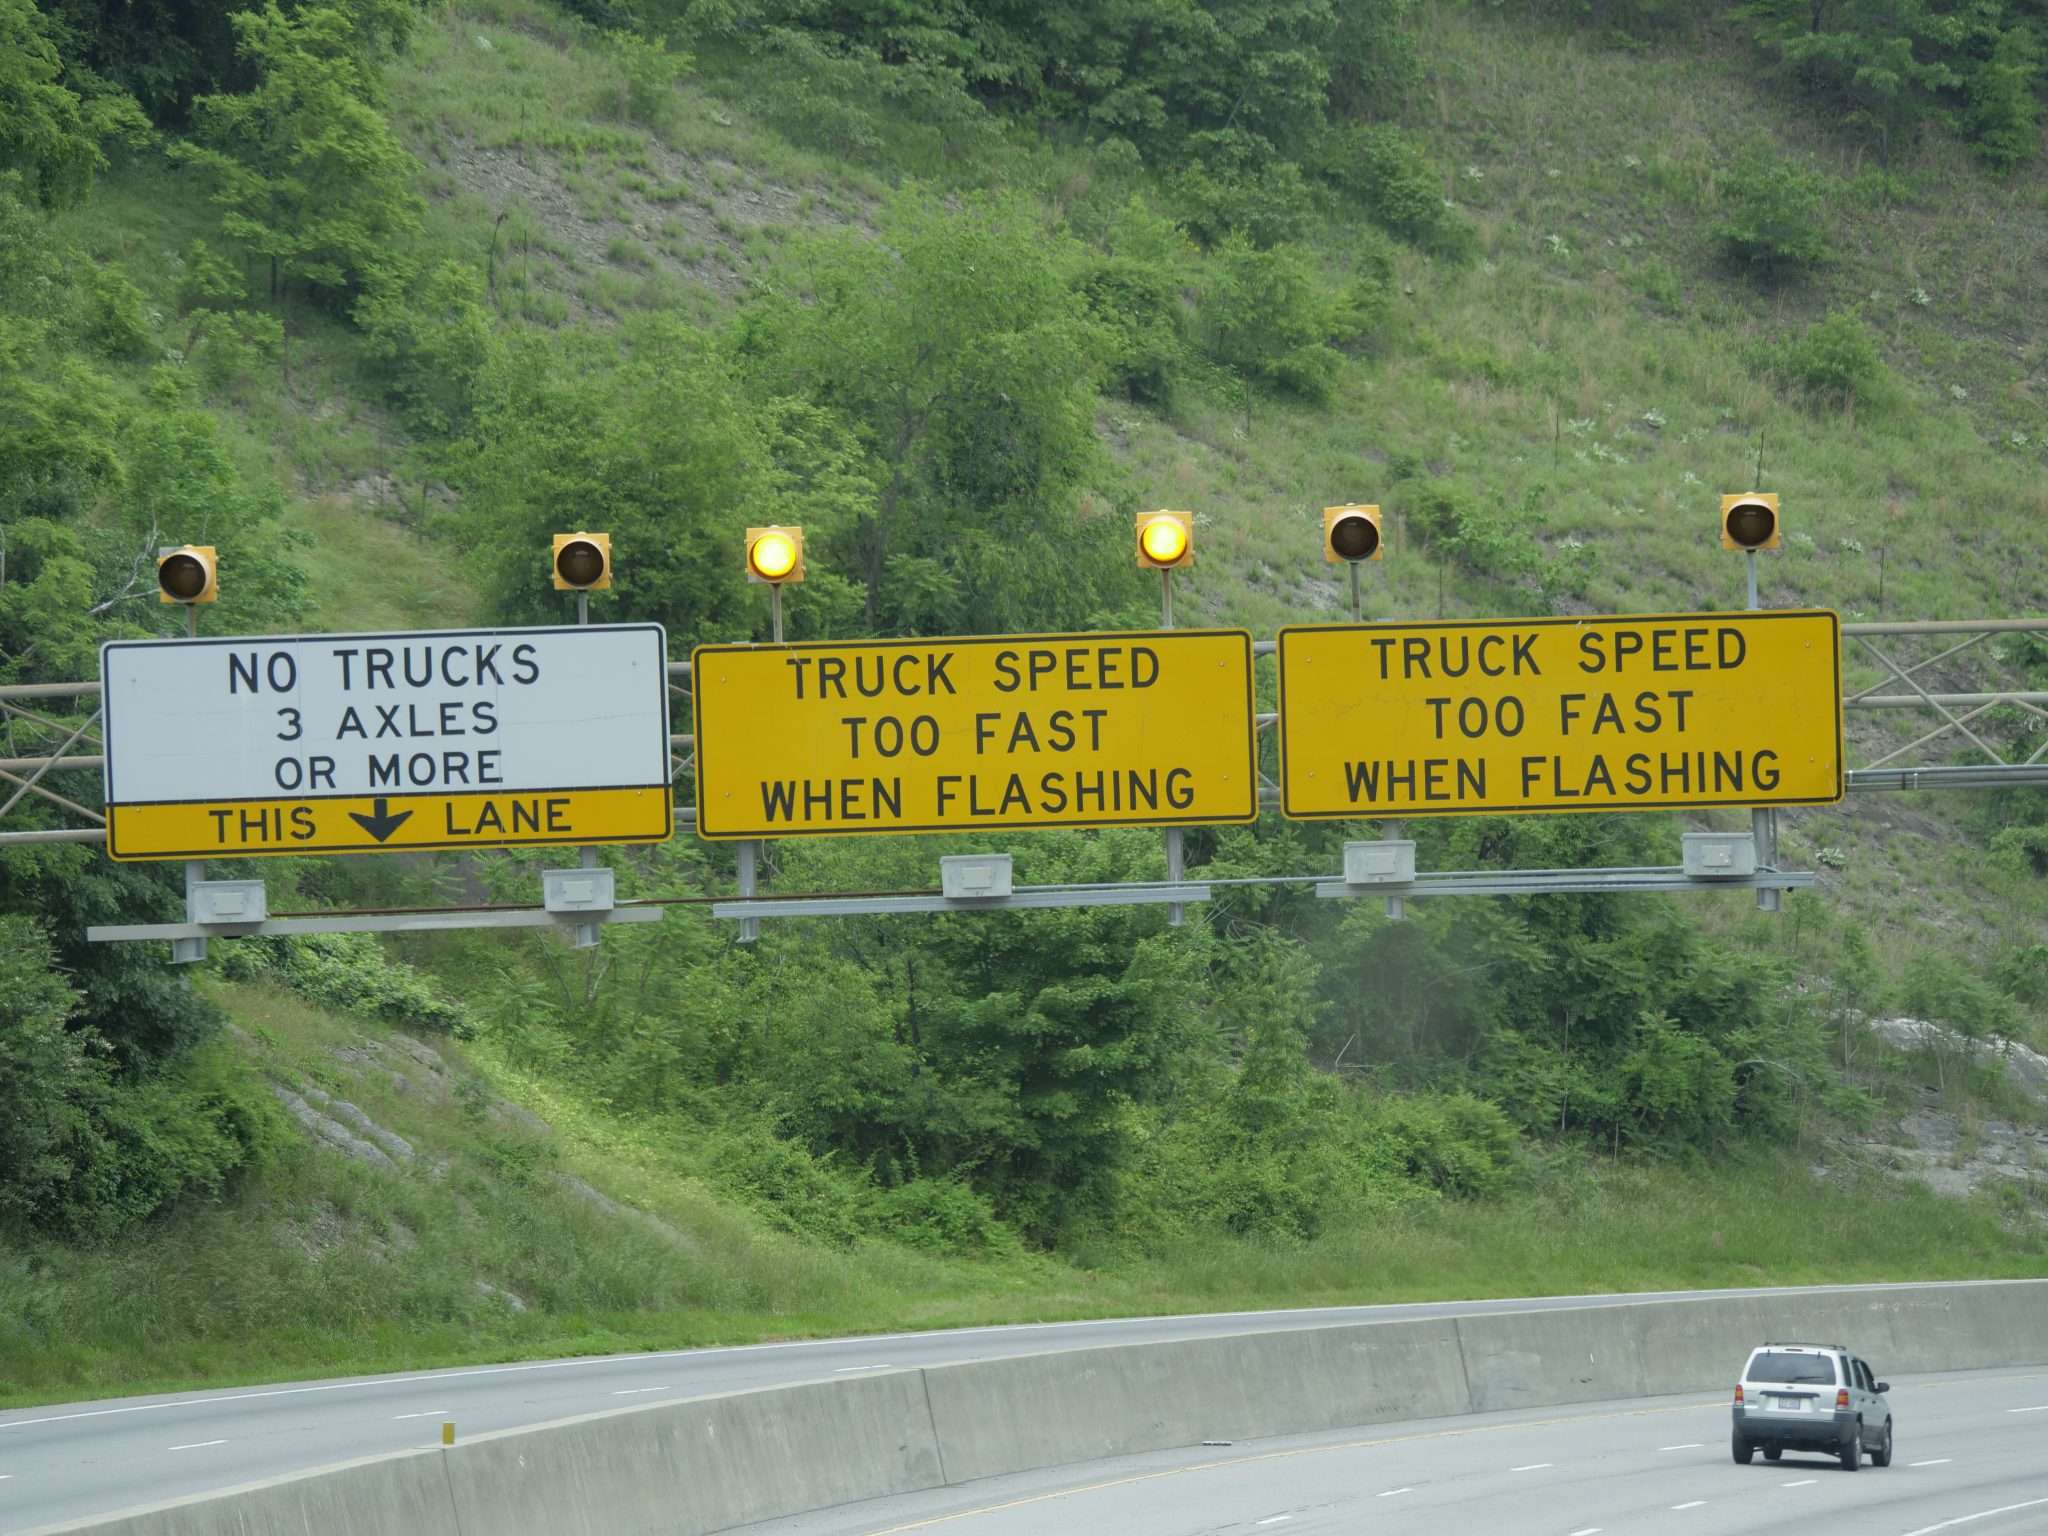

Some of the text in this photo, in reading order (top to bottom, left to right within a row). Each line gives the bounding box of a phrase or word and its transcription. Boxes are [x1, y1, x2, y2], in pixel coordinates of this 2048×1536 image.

[229, 643, 540, 694] NO TRUCKS
[787, 647, 1159, 699] TRUCK SPEED
[1371, 627, 1747, 679] TRUCK SPEED
[277, 701, 498, 740] 3 AXLES
[842, 709, 1108, 758] TOO FAST
[1426, 690, 1693, 739] TOO FAST
[275, 750, 503, 790] OR MORE
[761, 768, 1194, 822] WHEN FLASHING
[1345, 750, 1780, 802] WHEN FLASHING
[209, 798, 572, 843] THIS LANE
